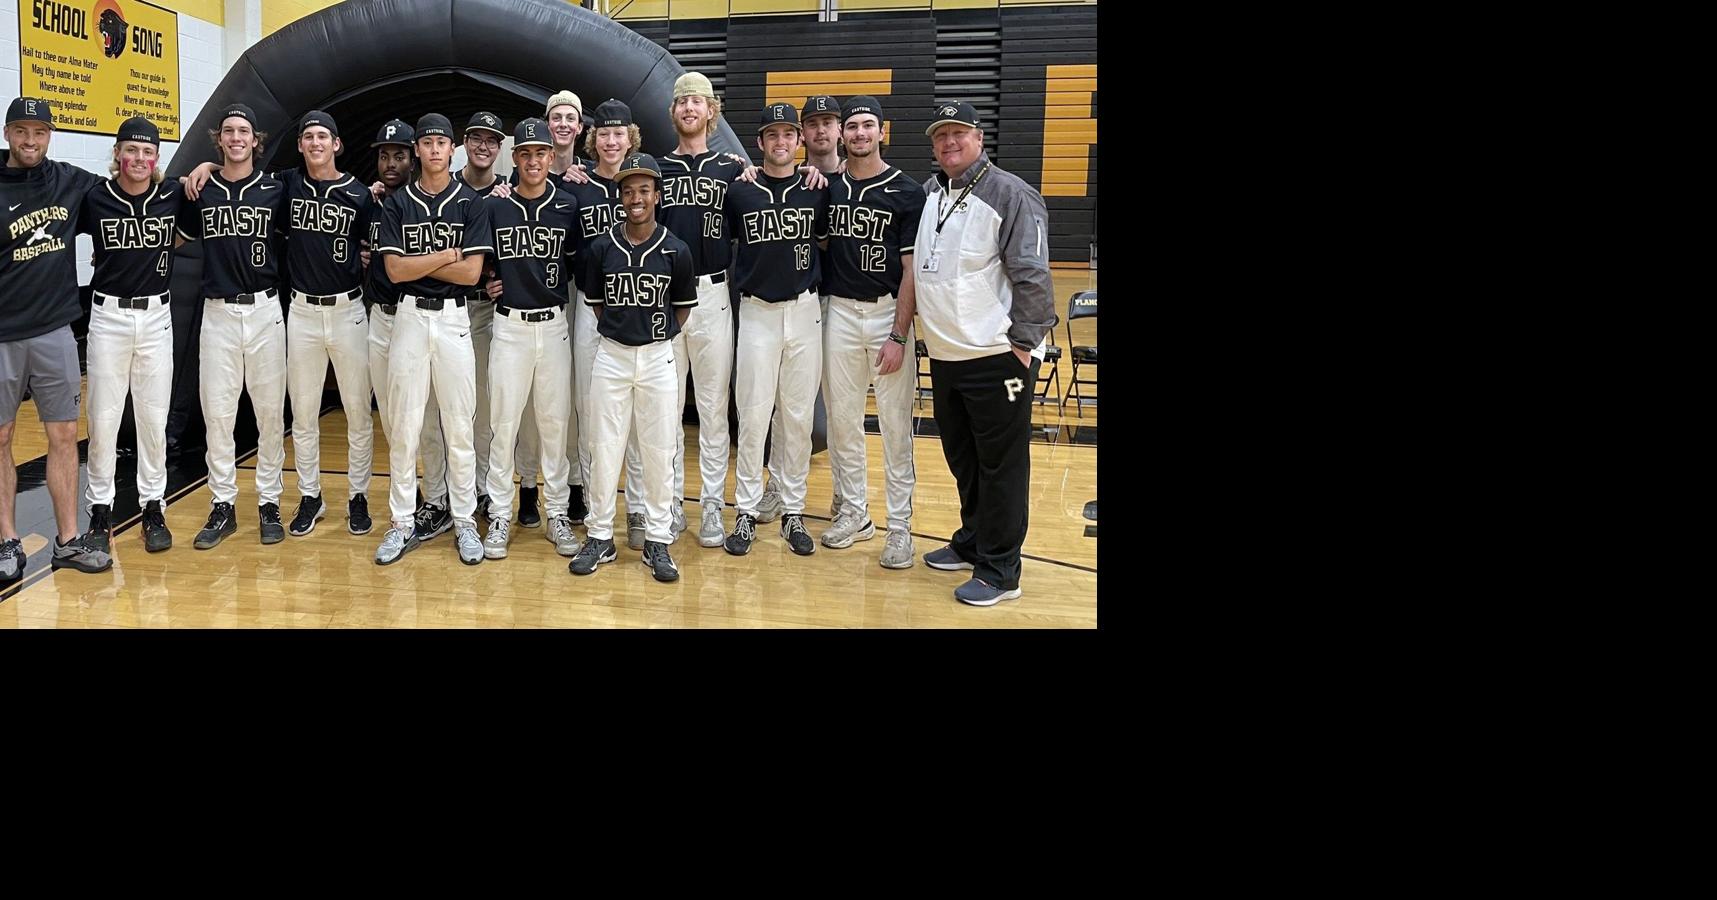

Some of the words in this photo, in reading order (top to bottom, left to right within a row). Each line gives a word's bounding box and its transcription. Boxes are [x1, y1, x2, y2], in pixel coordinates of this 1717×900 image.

[32, 0, 88, 40] SCHOOL
[132, 26, 162, 58] SONG
[22, 46, 34, 57] Hail
[35, 49, 42, 59] to
[43, 51, 57, 62] thee
[57, 55, 67, 64] our
[68, 56, 82, 67] Alma
[83, 59, 98, 70] Mater
[32, 64, 44, 77] May
[45, 67, 56, 79] thy
[56, 70, 72, 80] name
[72, 72, 80, 81] be
[81, 73, 92, 83] told
[130, 68, 141, 79] Thou
[141, 72, 149, 80] our
[150, 73, 161, 83] guide
[162, 75, 166, 84] in
[40, 81, 57, 92] Where
[58, 84, 75, 95] above
[76, 87, 86, 97] the
[124, 94, 138, 105] Where
[126, 83, 140, 92] quest
[140, 84, 148, 92] for
[147, 85, 170, 99] knowledge
[25, 100, 37, 116] E
[64, 101, 88, 112] splendor
[121, 107, 133, 117] dear
[145, 111, 156, 121] East
[156, 112, 169, 122] Senior
[773, 105, 785, 120] E
[816, 97, 827, 111] E
[58, 114, 74, 125] Black
[75, 116, 85, 126] and
[85, 117, 98, 127] Gold
[385, 125, 397, 140] P
[525, 124, 536, 139] E
[629, 155, 640, 169] E
[660, 176, 729, 210] EAST
[201, 205, 272, 239] EAST
[290, 198, 357, 237] EAST
[703, 211, 723, 239] 19
[742, 208, 815, 245] EAST
[100, 215, 175, 250] EAST
[402, 221, 465, 256] EAST
[496, 225, 566, 260] EAST
[251, 241, 266, 267] 8
[333, 237, 348, 263] 9
[794, 243, 811, 271] 13
[860, 244, 887, 272] 12
[156, 251, 169, 276] 4
[546, 262, 559, 289] 3
[604, 272, 672, 308] EAST
[651, 311, 667, 340] 2
[1003, 376, 1025, 403] P
